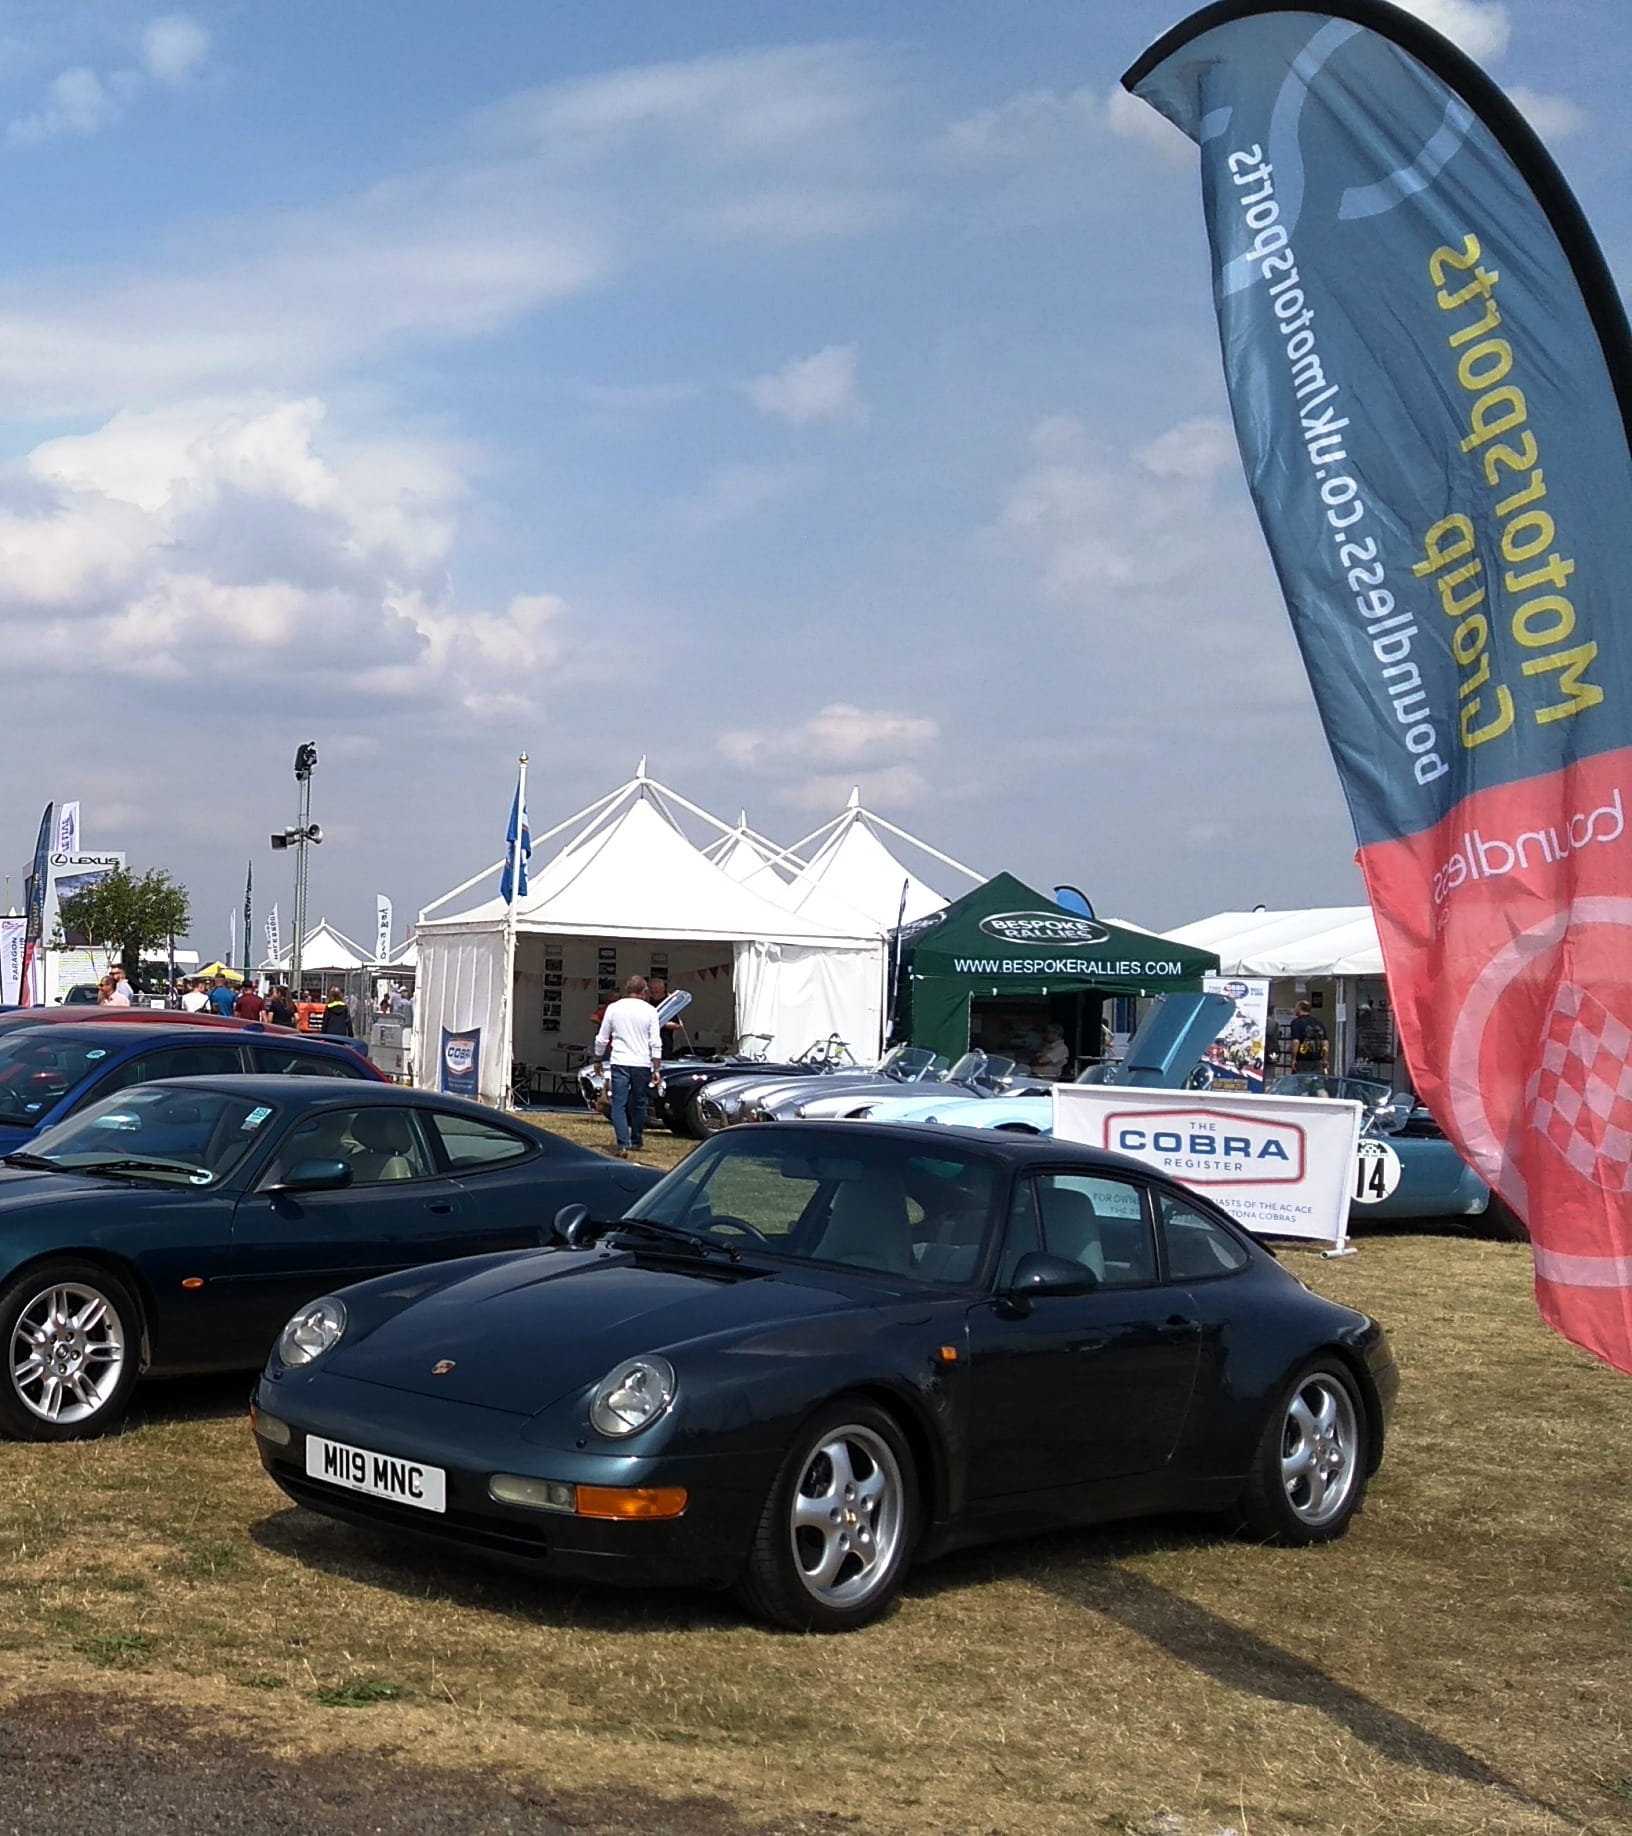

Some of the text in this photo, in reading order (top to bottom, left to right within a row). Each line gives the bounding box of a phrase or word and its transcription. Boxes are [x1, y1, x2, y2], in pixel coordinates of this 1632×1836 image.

[69, 856, 120, 865] LEXUS
[990, 919, 1092, 932] BESPOKE
[1004, 928, 1093, 940] RALLIES
[954, 958, 1182, 975] WWW.BESPOKERALLIES.COM
[1189, 1122, 1217, 1132] THE
[1119, 1129, 1290, 1161] COBRA
[1164, 1158, 1243, 1172] REGISTER
[1356, 1157, 1386, 1198] 14
[1243, 1200, 1257, 1208] OF
[1259, 1202, 1278, 1211] THE
[1279, 1204, 1292, 1212] AC
[1295, 1205, 1313, 1214] ACE
[1258, 1212, 1296, 1223] COBRAS
[373, 1456, 424, 1499] MNC
